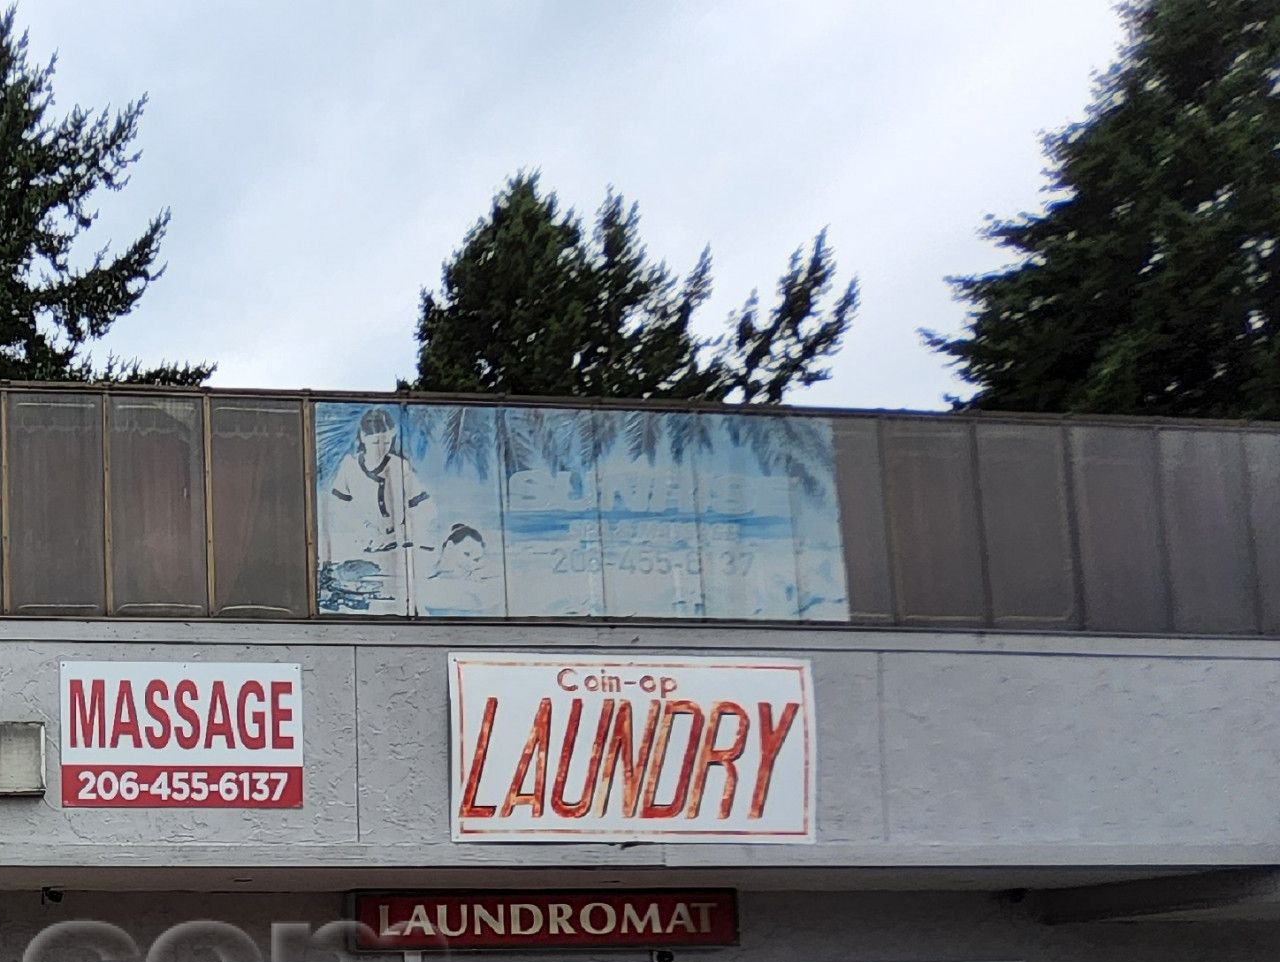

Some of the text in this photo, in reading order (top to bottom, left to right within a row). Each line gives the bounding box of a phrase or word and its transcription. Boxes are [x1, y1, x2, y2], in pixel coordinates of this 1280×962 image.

[556, 667, 678, 698] Coin-op
[69, 679, 295, 750] MASSAGE
[459, 696, 800, 820] LAUNDRY
[78, 771, 288, 801] 206-455-6137
[379, 902, 717, 937] LAUNDROMAT
